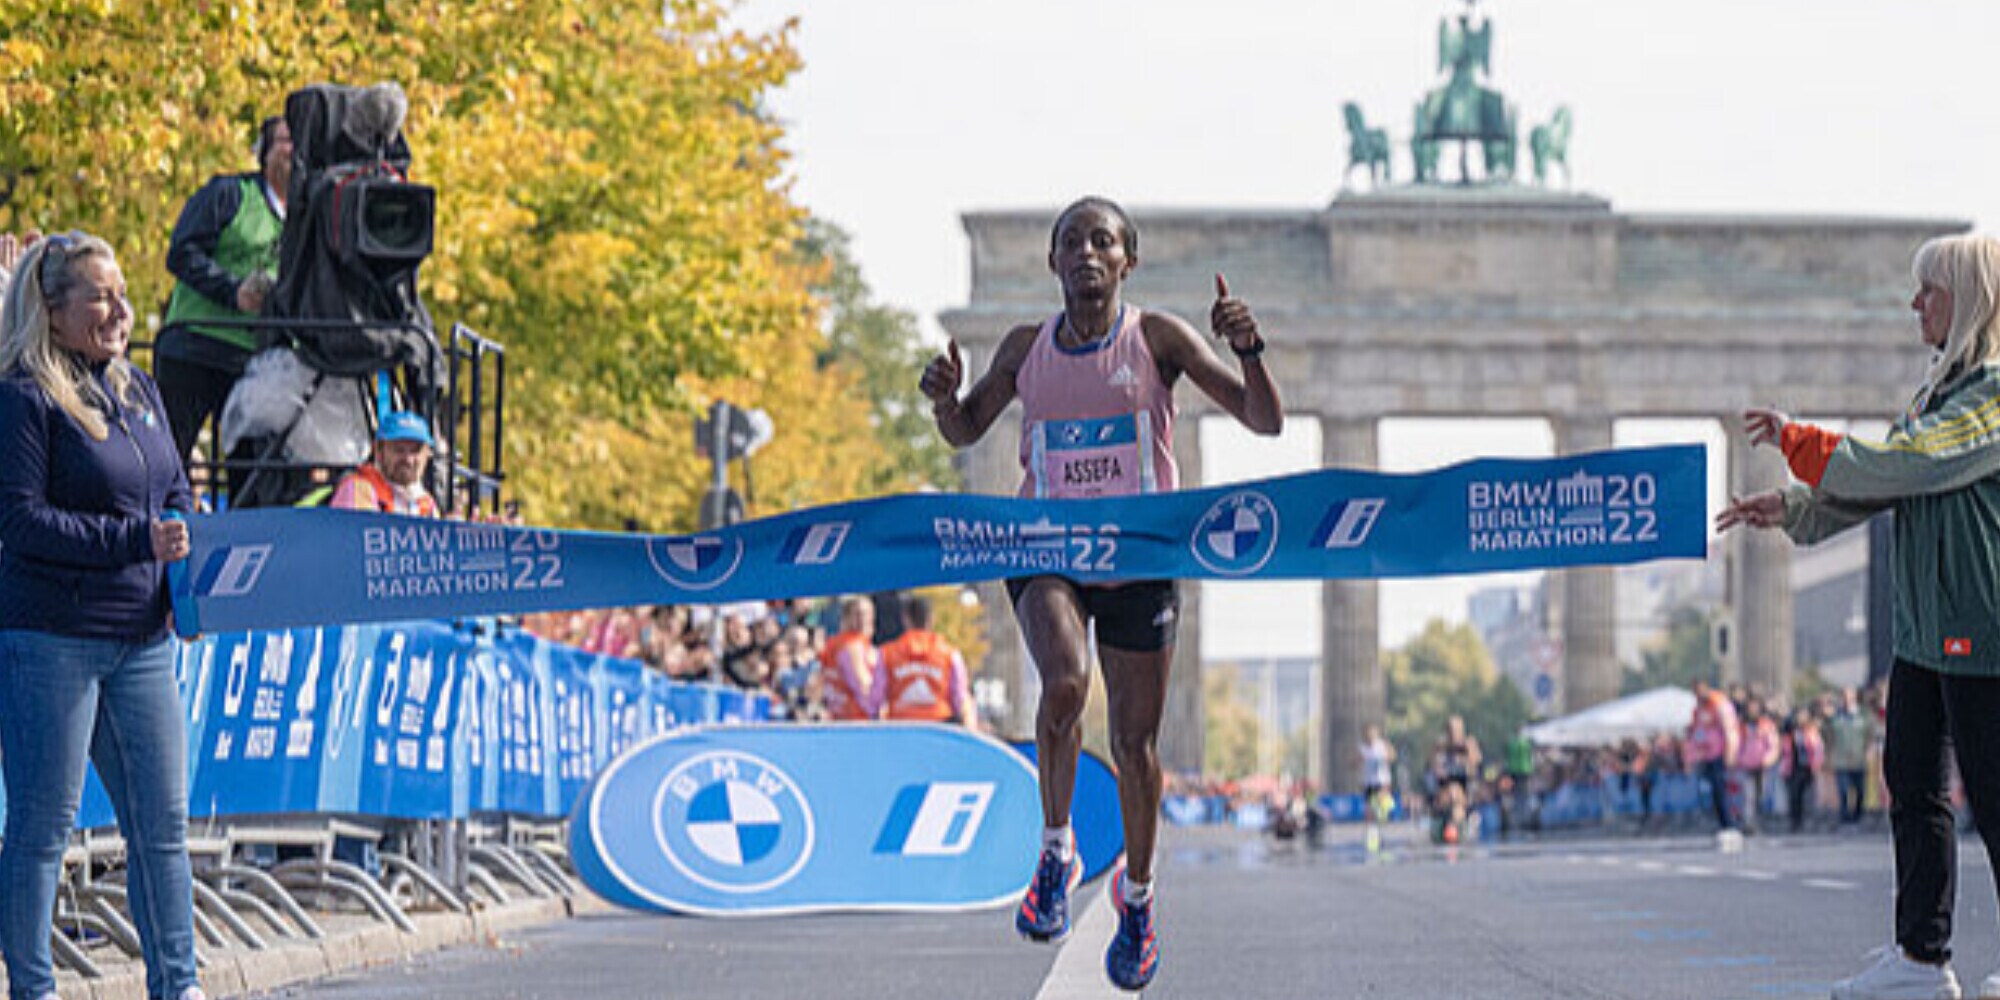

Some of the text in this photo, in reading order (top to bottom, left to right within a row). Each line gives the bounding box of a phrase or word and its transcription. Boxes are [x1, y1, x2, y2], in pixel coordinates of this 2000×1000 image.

[1468, 479, 1553, 509] BMW
[1607, 472, 1656, 508] 20
[1469, 507, 1554, 530] BERLIN
[1608, 508, 1659, 545] 22
[364, 526, 450, 555] BMW
[1071, 536, 1117, 571] 22
[1471, 525, 1607, 552] MARATHON
[366, 552, 454, 577] BERLIN
[511, 556, 564, 589] 22
[367, 572, 509, 600] MARATHON
[671, 759, 785, 801] BMW
